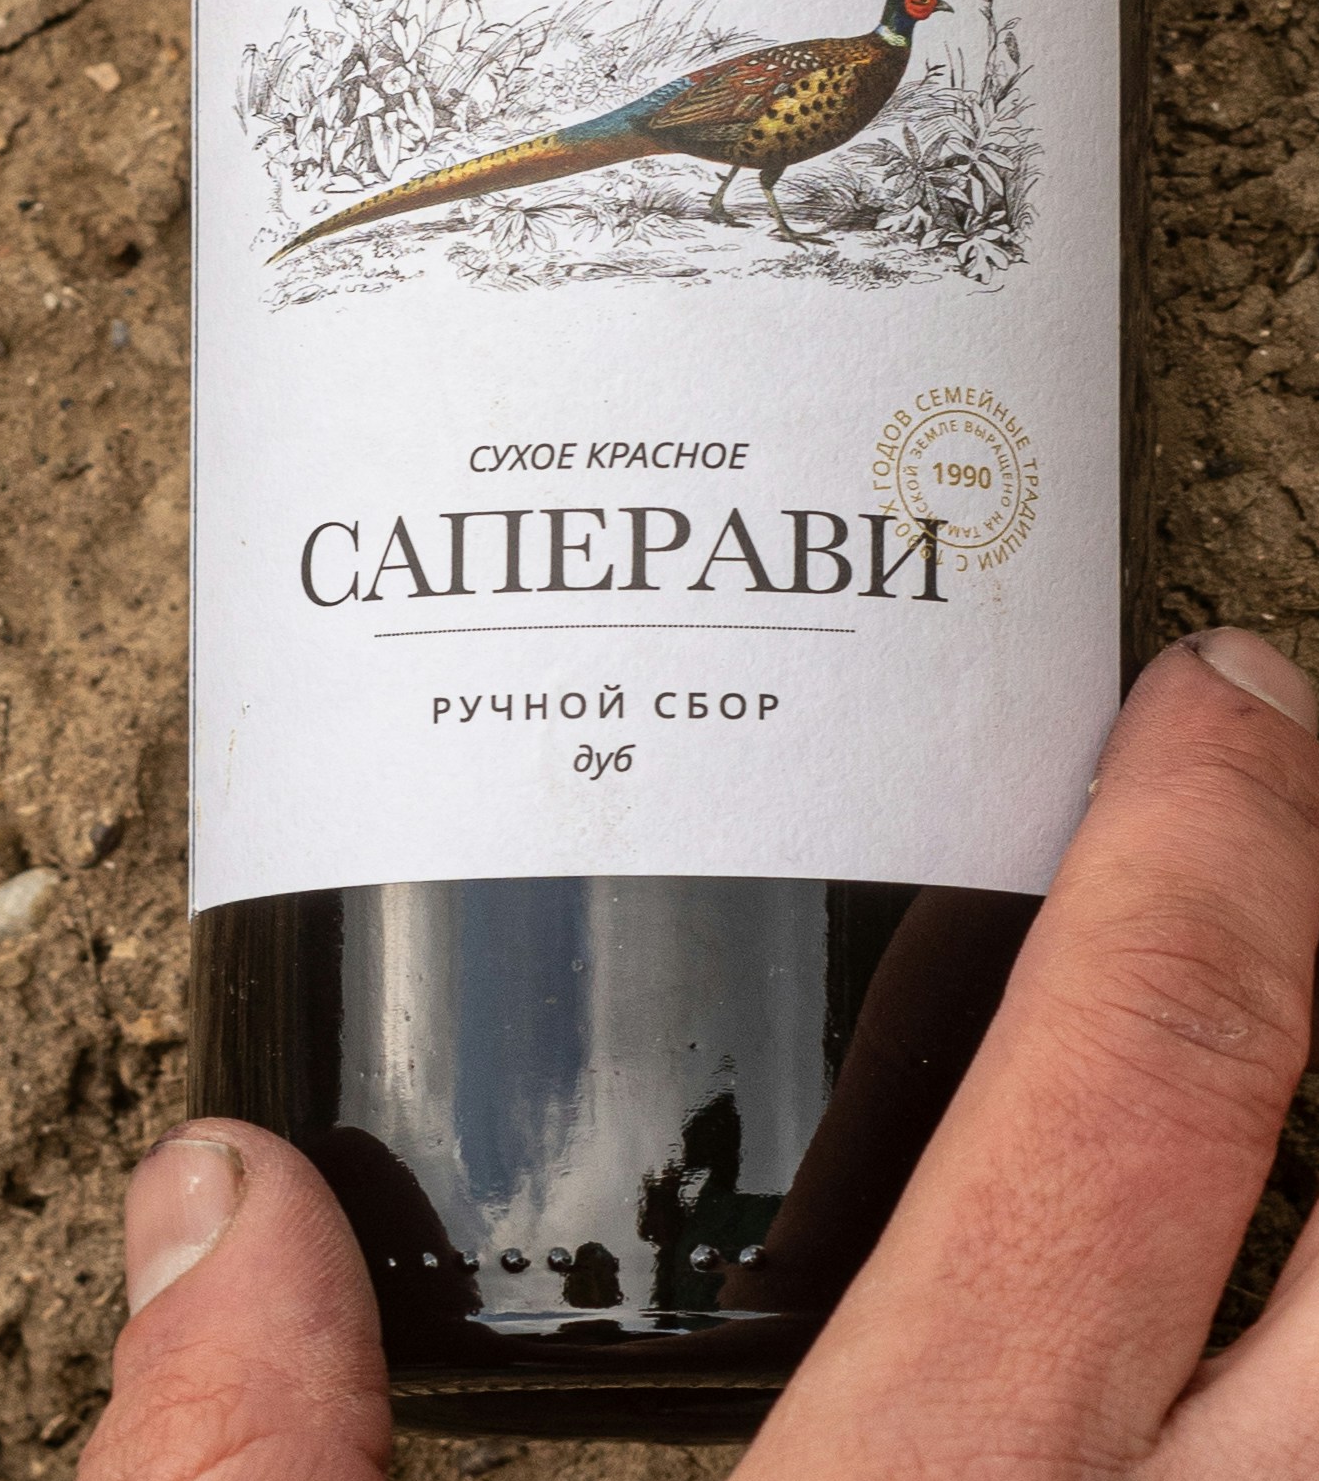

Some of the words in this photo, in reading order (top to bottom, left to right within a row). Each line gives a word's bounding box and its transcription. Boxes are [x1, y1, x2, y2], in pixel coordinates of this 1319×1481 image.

[915, 386, 1030, 451] СЕМЕЙНЫЕ
[469, 442, 578, 473] СУХОЕ
[585, 441, 751, 470] КРАСНОЕ
[872, 409, 913, 491] ГОДОВ
[910, 419, 959, 460] ЗЕМЛЕ
[932, 462, 992, 490] 1990
[964, 420, 1012, 508] ВЫРАЩЕНО
[977, 458, 1039, 572] ТРАДИЦИИ
[984, 510, 1003, 531] НА
[300, 506, 949, 608] САПЕРАВИ
[956, 554, 969, 572] С
[433, 683, 625, 725] РУЧНОЙ
[654, 691, 780, 721] СБОР
[573, 743, 637, 782] дуб
